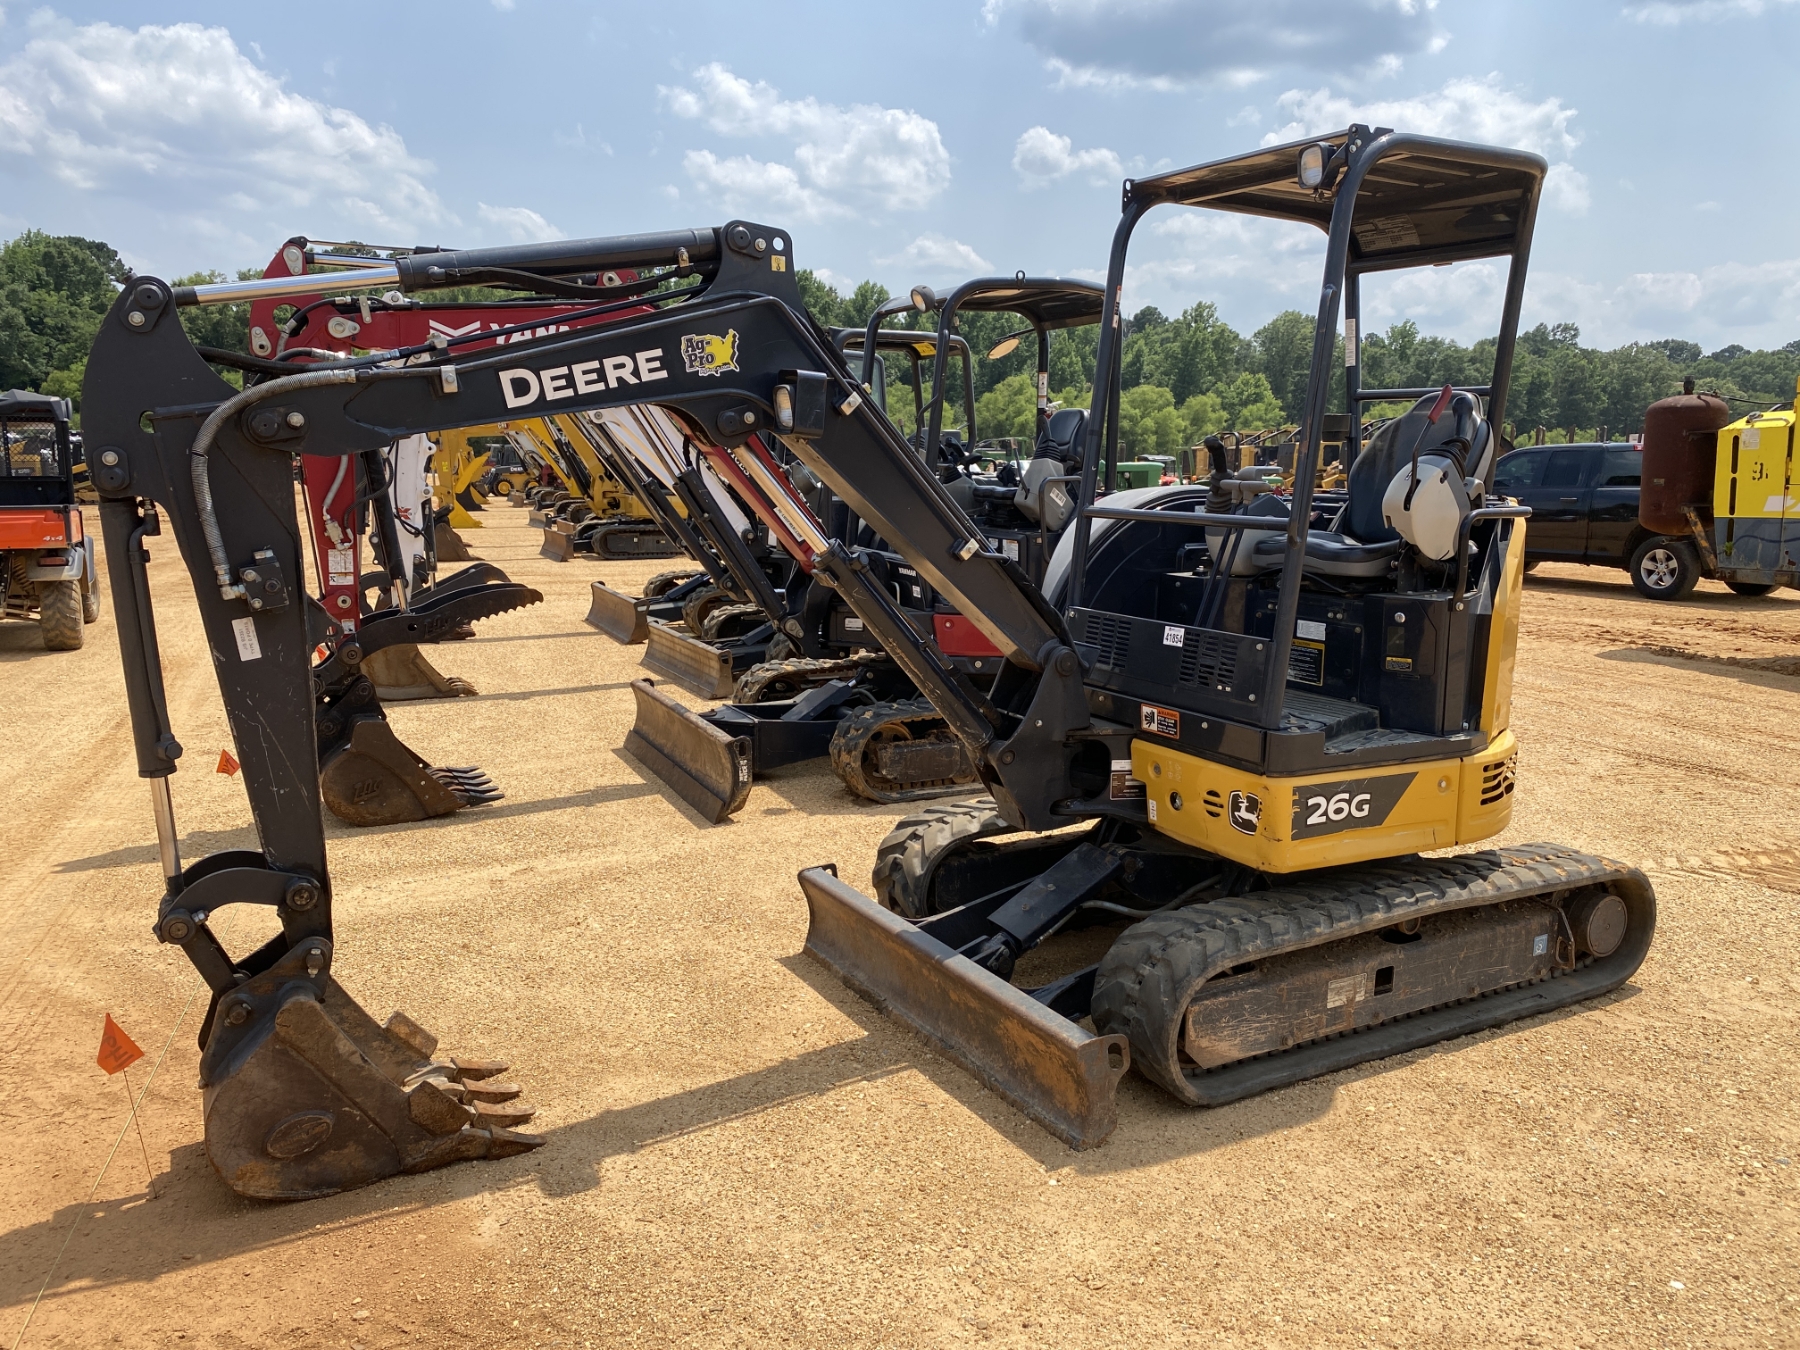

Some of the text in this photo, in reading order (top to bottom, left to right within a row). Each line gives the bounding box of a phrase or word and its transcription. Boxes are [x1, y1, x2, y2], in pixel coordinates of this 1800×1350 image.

[687, 352, 715, 369] Pro
[499, 348, 669, 409] DEERE
[898, 567, 917, 577] YANMAR
[1165, 632, 1183, 645] 41854
[1306, 793, 1371, 825] 26G
